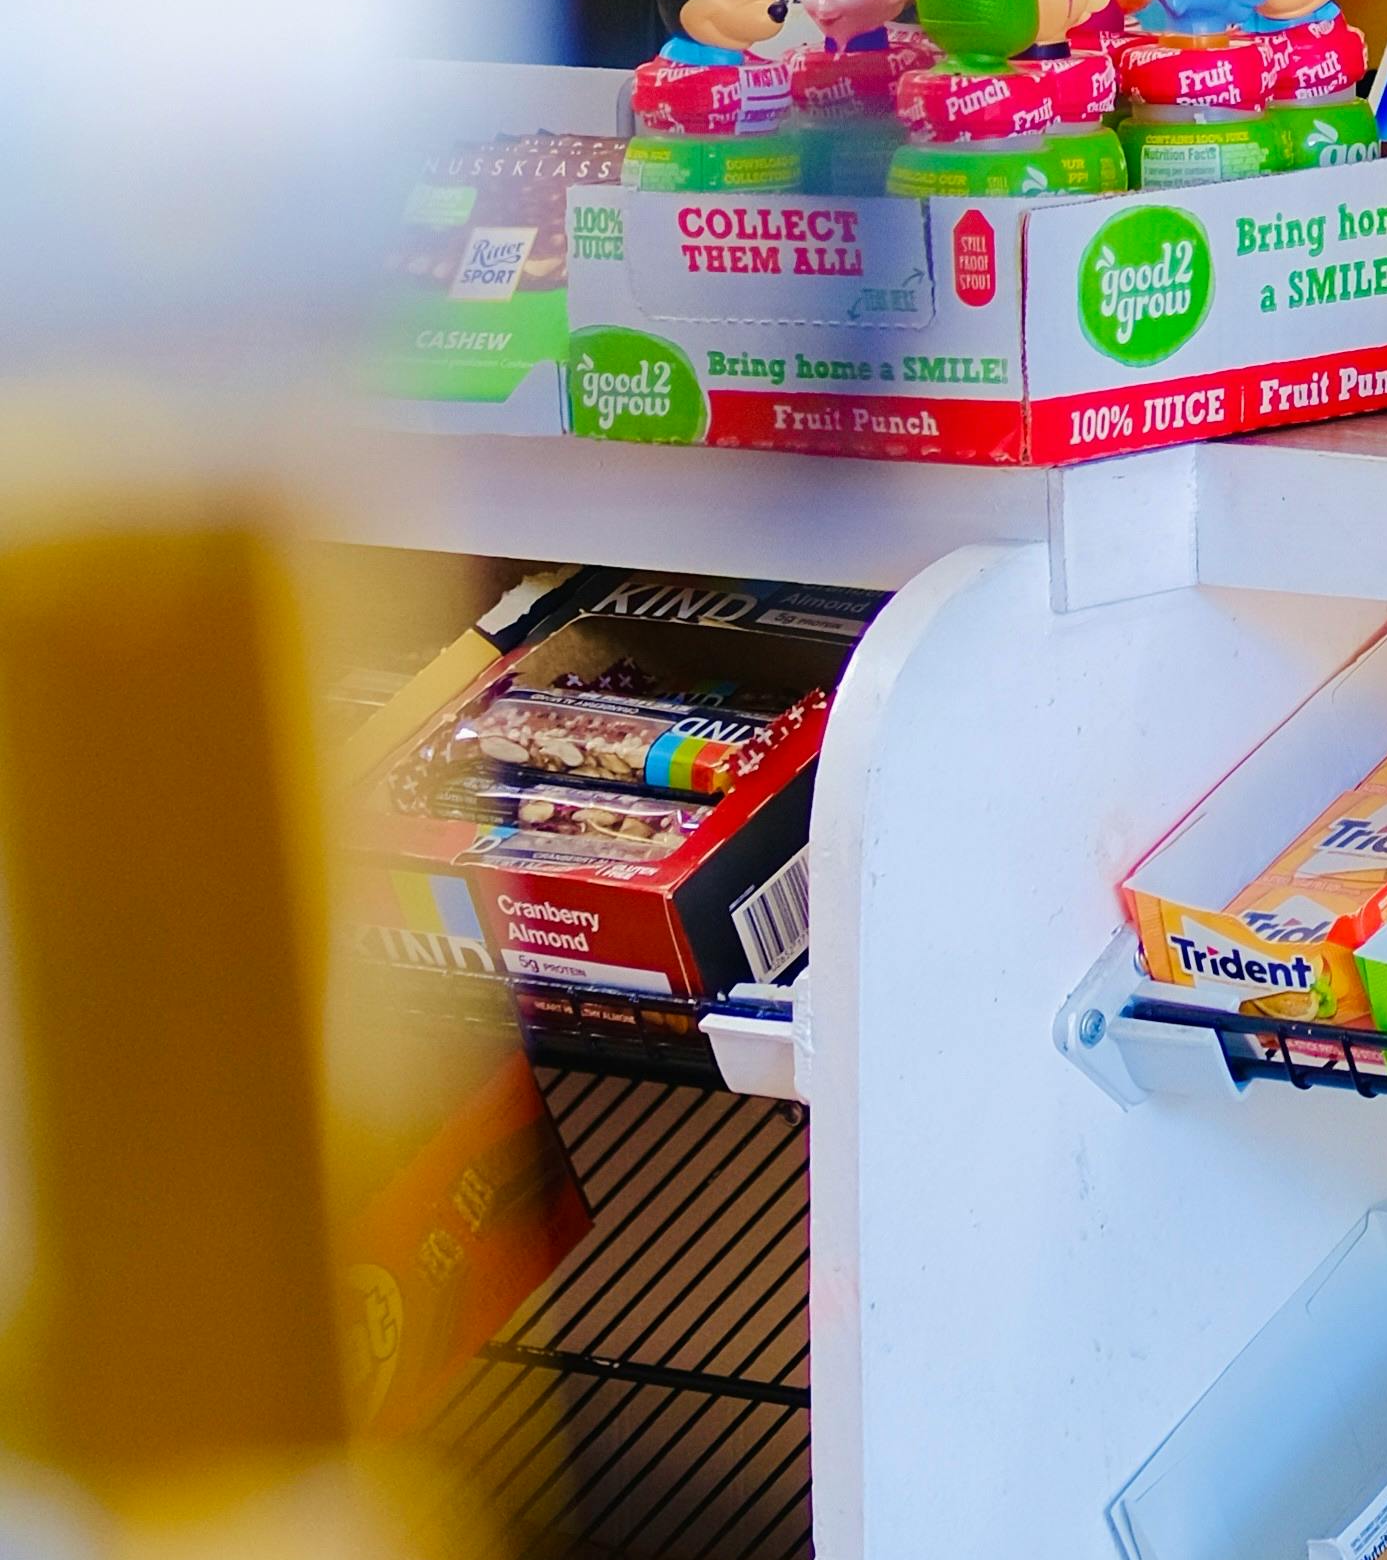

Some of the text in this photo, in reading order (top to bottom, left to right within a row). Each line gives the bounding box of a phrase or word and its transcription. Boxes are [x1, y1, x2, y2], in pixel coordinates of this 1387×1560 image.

[1178, 61, 1234, 94] Fruit
[945, 78, 1011, 122] Punch
[572, 206, 625, 235] 100%
[677, 206, 859, 244] COLLECT
[1235, 212, 1327, 258] Bring
[572, 236, 625, 261] JUICE
[960, 234, 987, 253] SPILL
[460, 267, 516, 285] SPORT
[681, 244, 865, 277] THEM ALL!
[960, 254, 989, 272] PROOF
[960, 272, 991, 291] SPOUT
[1259, 284, 1277, 313] a
[1117, 285, 1192, 345] grow
[414, 330, 513, 352] CASHEW
[706, 351, 1010, 385] Bring home a SMILE!
[773, 404, 940, 437] Fruit Punch
[1069, 404, 1134, 446] 100%
[1142, 388, 1226, 434] JUICE
[1258, 373, 1330, 415] Fruit
[594, 581, 758, 624] KIND
[773, 609, 795, 624] 5g
[782, 591, 868, 615] Almond
[497, 894, 600, 932] Cranberry
[508, 924, 590, 954] Almond
[518, 954, 587, 978] 5g PROTEIN
[1169, 935, 1316, 993] Trident
